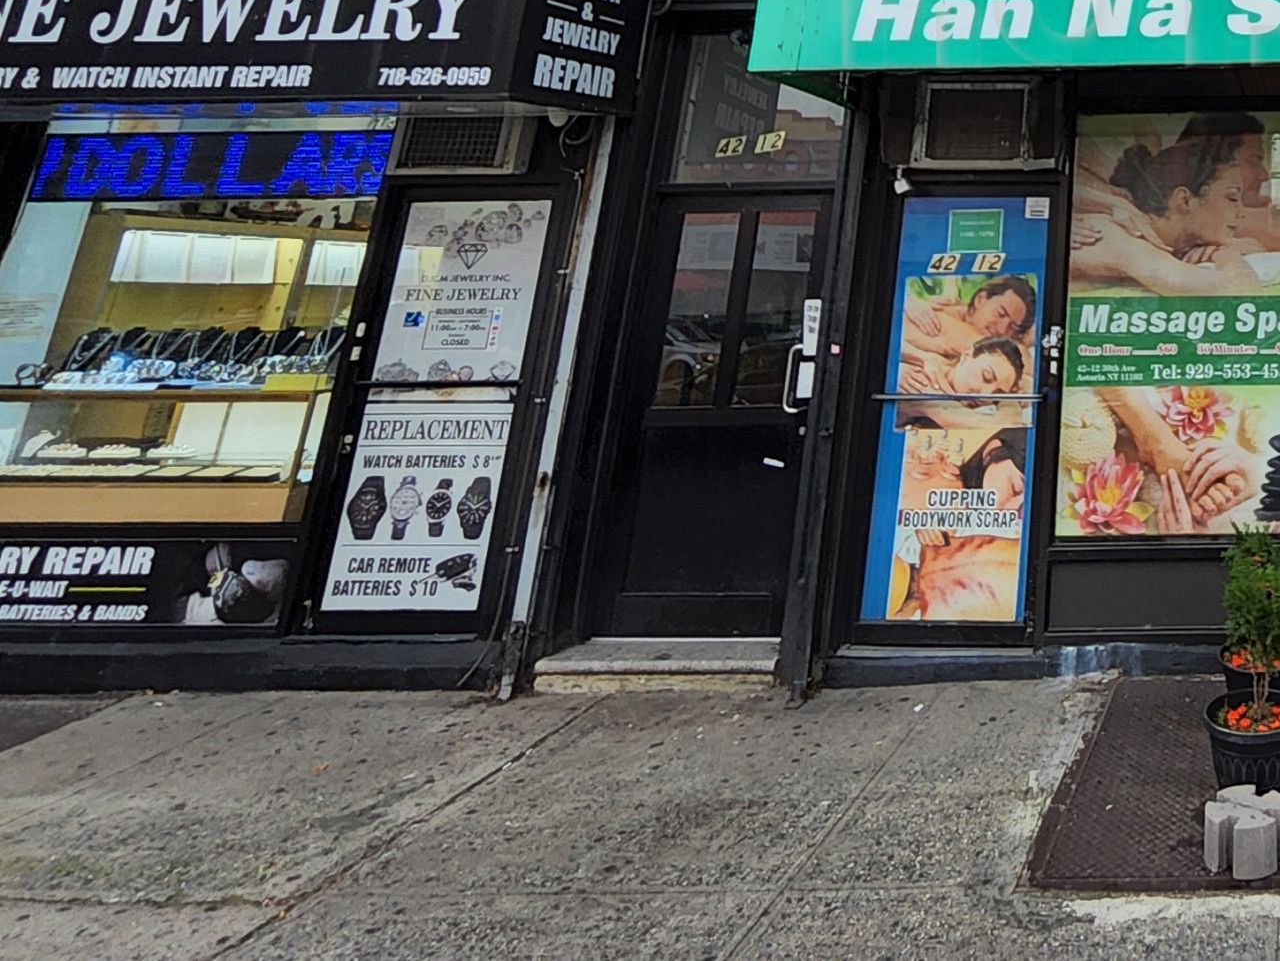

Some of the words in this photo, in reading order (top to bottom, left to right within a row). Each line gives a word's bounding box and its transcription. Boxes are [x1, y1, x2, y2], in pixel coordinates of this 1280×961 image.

[581, 1, 594, 22] &
[542, 16, 621, 56] JEWELRY
[21, 67, 40, 89] &
[52, 66, 130, 89] WATCH
[132, 65, 228, 89] INSTANT
[230, 64, 313, 88] REPAIR
[378, 66, 492, 87] 718-626-0959
[533, 53, 615, 98] REPAIR
[718, 139, 744, 155] 42
[759, 134, 783, 151] 12
[930, 255, 957, 271] 42
[976, 254, 1001, 270] 12
[449, 273, 489, 283] JEWELRY
[404, 288, 444, 302] FINE
[446, 287, 522, 302] JEWELRY
[1078, 304, 1226, 340] Massage
[440, 338, 470, 346] CLOSED
[1102, 343, 1132, 356] Hour
[1150, 363, 1182, 380] Tel:
[363, 419, 510, 441] REPLACEMENT
[362, 454, 402, 469] WATCH
[404, 454, 467, 469] BATTERIES
[927, 491, 996, 508] CUPPING
[903, 511, 972, 528] BODYWORK
[976, 510, 1017, 528] SCRAP
[42, 546, 156, 576] REPAIR
[347, 557, 373, 574] CAR
[377, 557, 432, 574] REMOTE
[331, 580, 402, 597] BATTERIES
[0, 604, 78, 620] BATTERIES
[77, 604, 93, 620] &
[92, 604, 149, 620] BANDS
